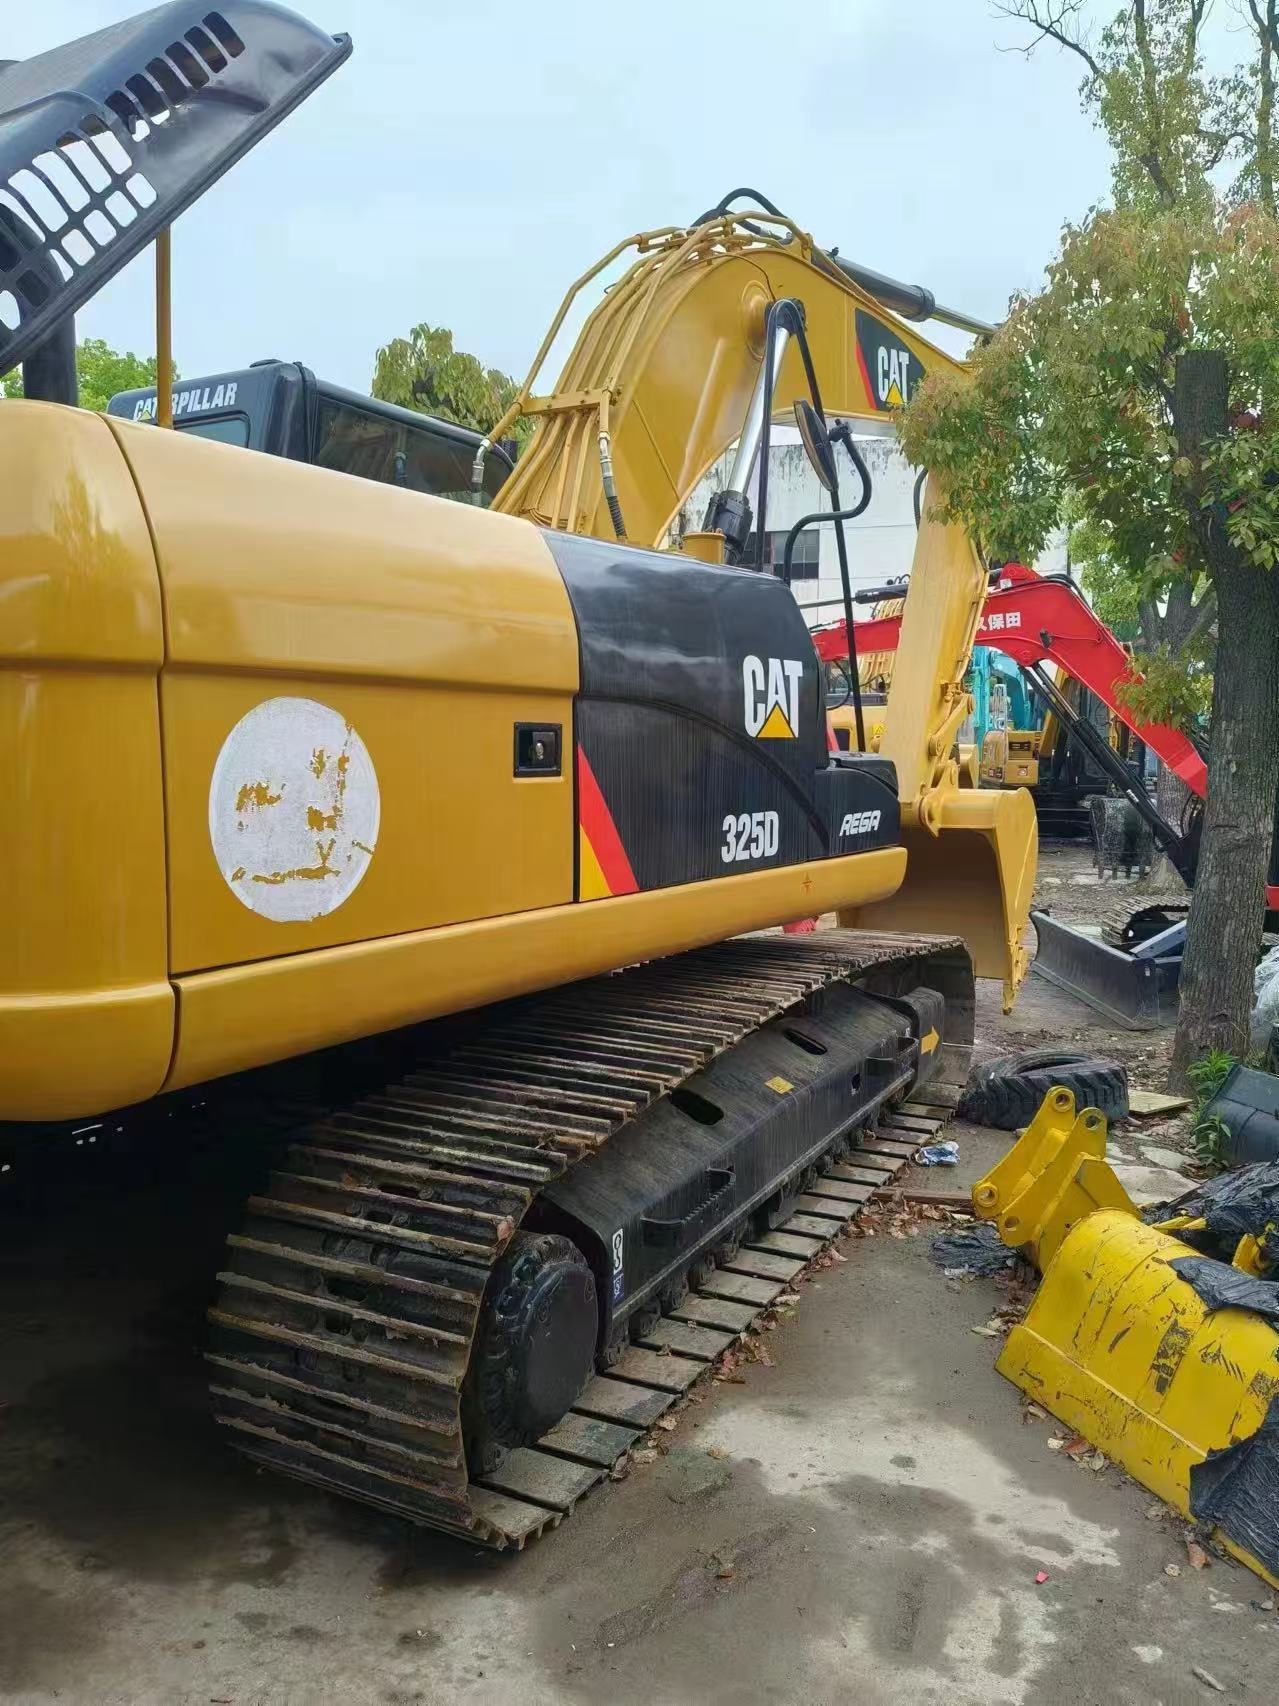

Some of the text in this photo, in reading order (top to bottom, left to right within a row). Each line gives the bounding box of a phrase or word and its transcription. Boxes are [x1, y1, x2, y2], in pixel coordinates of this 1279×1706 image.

[133, 382, 238, 422] CATRPILLAR
[877, 346, 909, 404] CAT
[743, 655, 803, 739] CAT
[721, 810, 779, 863] 325D
